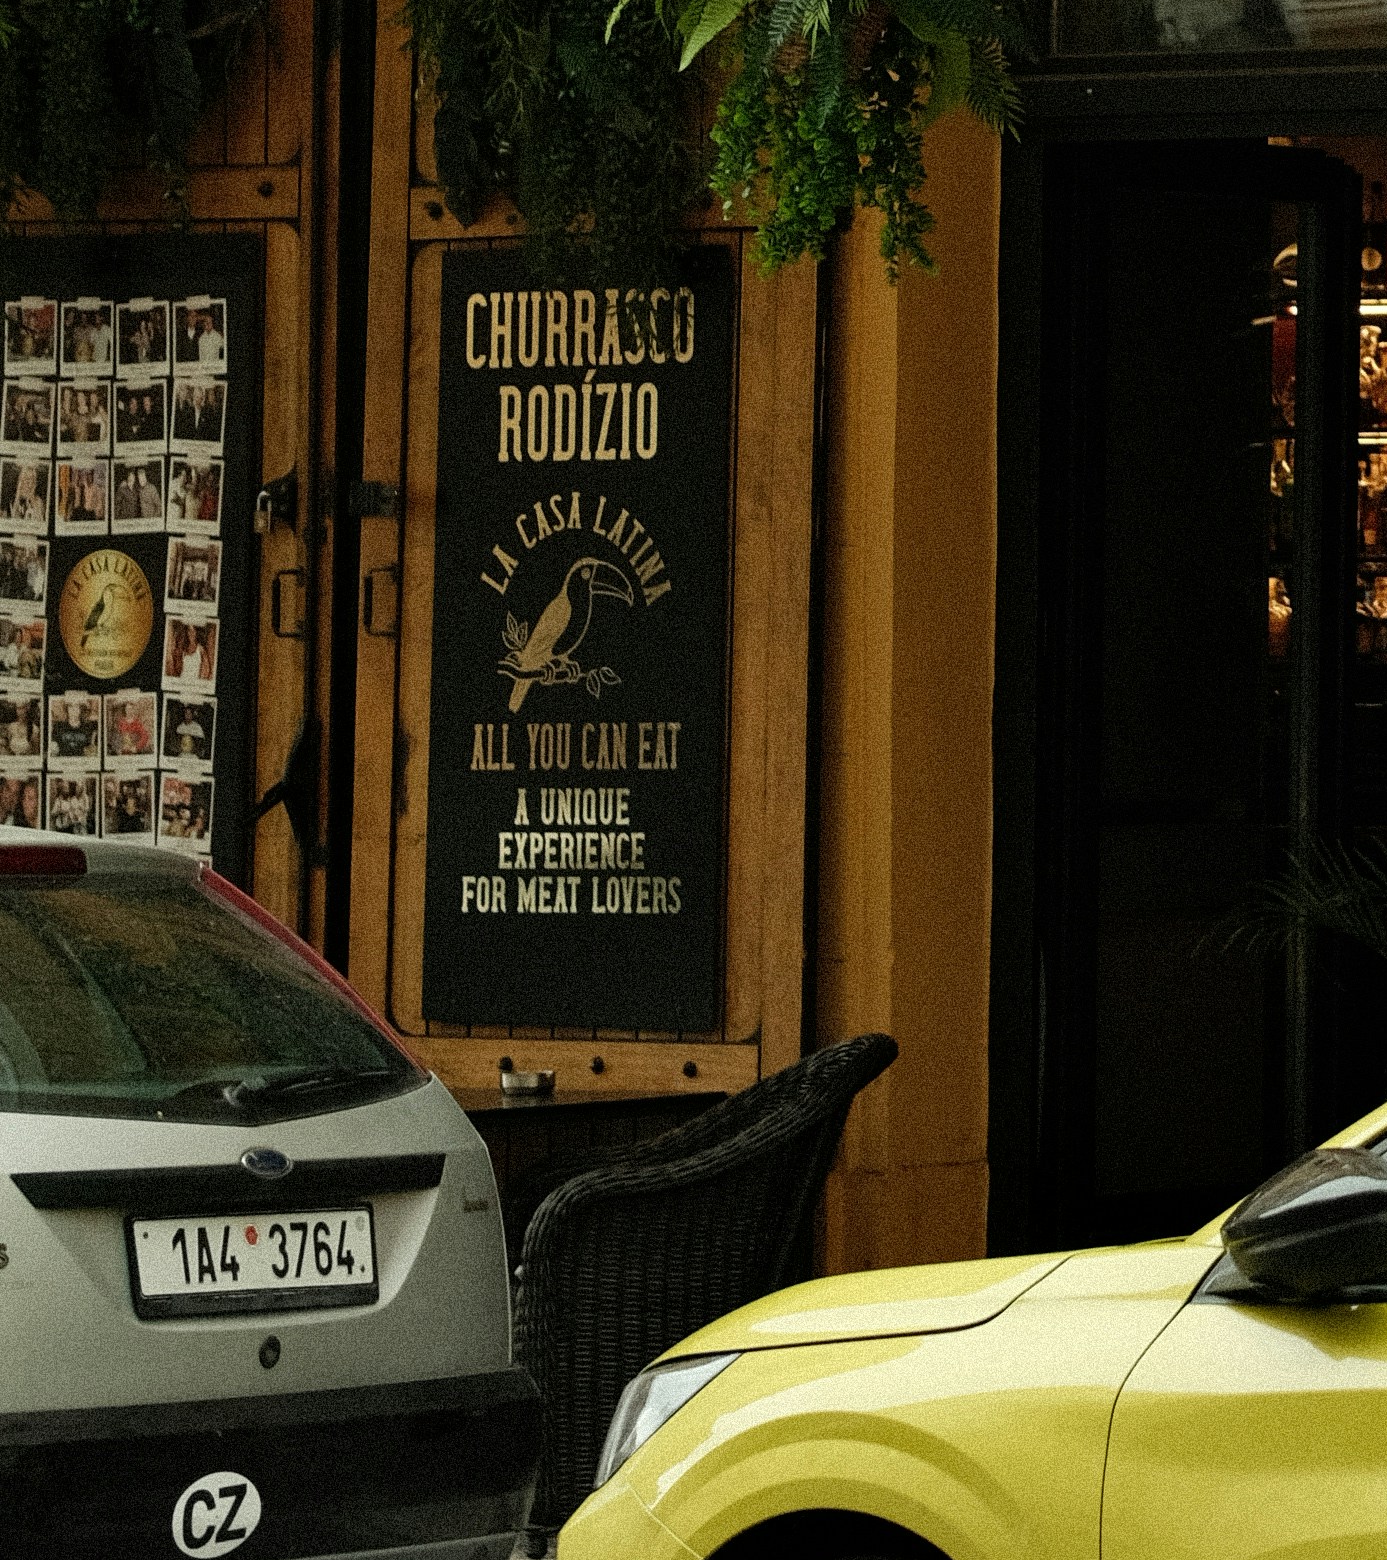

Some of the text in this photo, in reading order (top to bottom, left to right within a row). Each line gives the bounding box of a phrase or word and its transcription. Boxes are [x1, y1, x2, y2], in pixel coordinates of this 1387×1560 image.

[466, 286, 695, 369] CHURRASCO
[498, 368, 659, 462] RODÍZIO
[479, 491, 672, 606] LA CASA LATINA
[469, 721, 682, 771] ALL YOU CAN EAT
[514, 787, 631, 826] A UNIQUE
[498, 832, 646, 870] EXPERIENCE
[461, 875, 682, 914] FOR MEAT LOVERS
[172, 1220, 355, 1284] 1A4 3764
[182, 1482, 248, 1550] CZ
